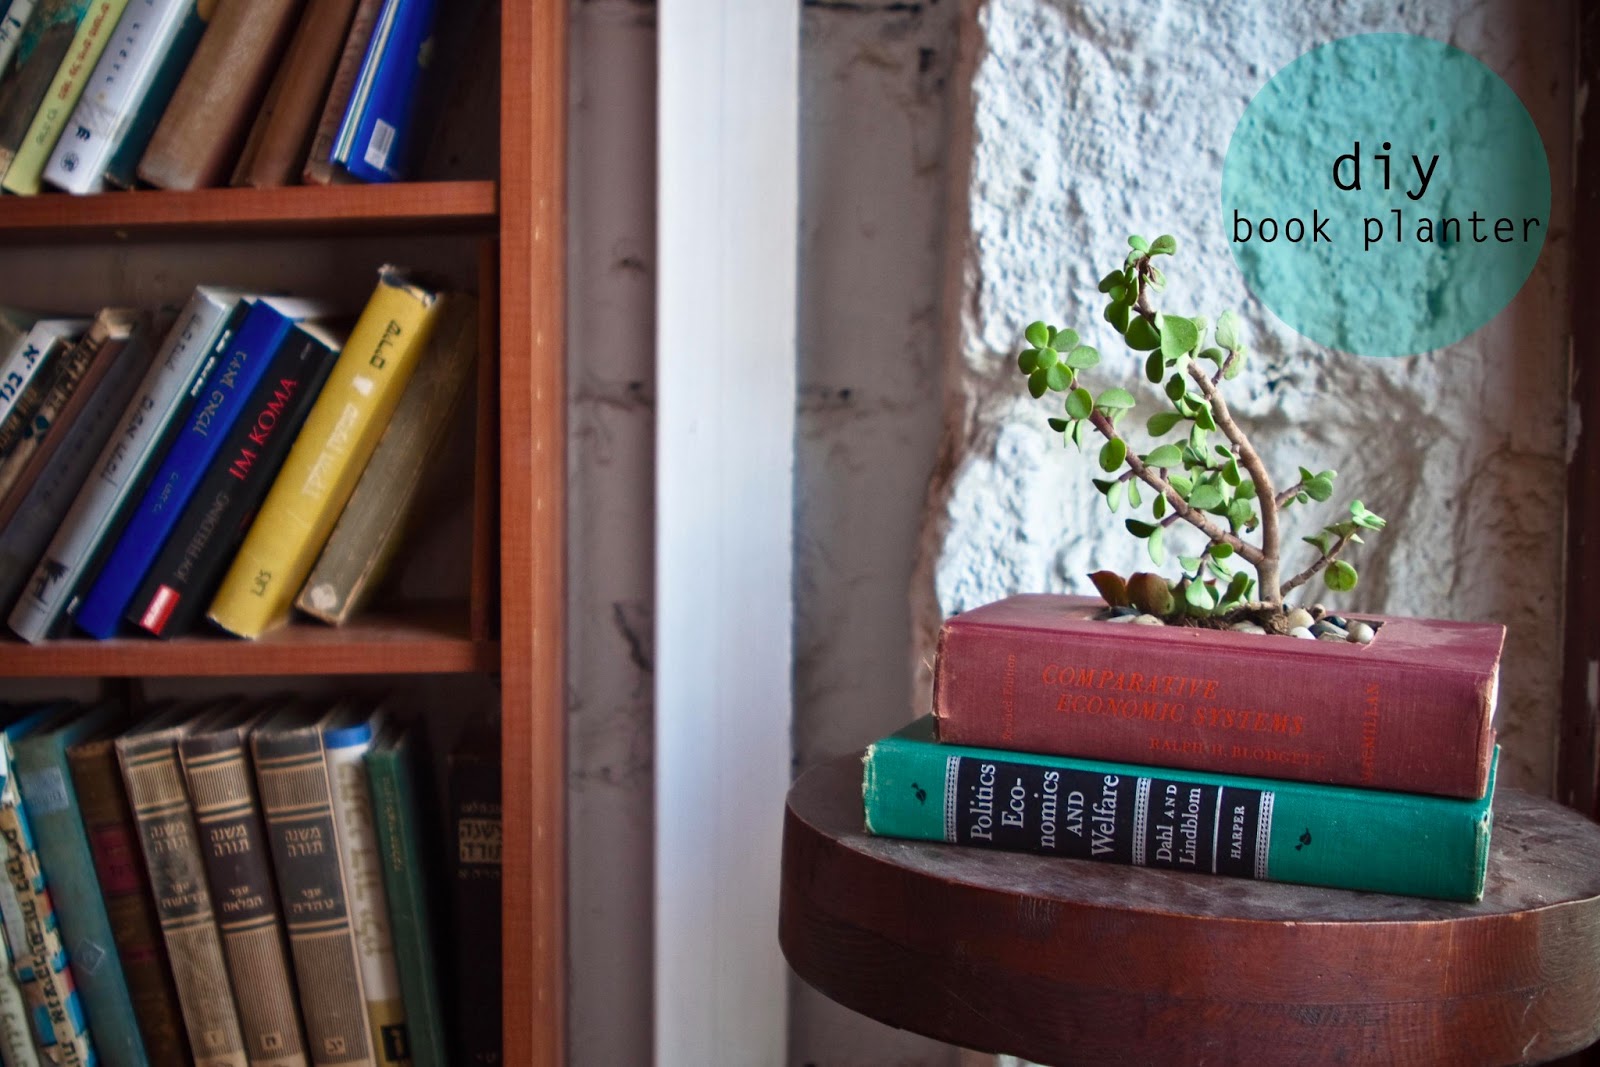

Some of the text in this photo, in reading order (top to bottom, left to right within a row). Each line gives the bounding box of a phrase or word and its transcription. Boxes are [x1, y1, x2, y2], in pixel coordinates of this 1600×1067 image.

[369, 319, 401, 370] שירים
[229, 377, 297, 480] IM KOMA
[1042, 664, 1220, 700] COMPARATIVE
[1056, 693, 1304, 737] ECONOMIC SYSTEMS
[1149, 737, 1203, 754] RALPH
[970, 763, 996, 842] Politics
[1001, 777, 1025, 829] Eco-
[1034, 770, 1060, 849] nomics
[1066, 790, 1085, 837] AND
[1092, 774, 1120, 856] Welfare
[1156, 784, 1178, 863] Dahl AND
[1179, 788, 1201, 865] Lindblom
[211, 823, 247, 842] משנה
[214, 838, 250, 857] תורה
[285, 826, 321, 843] משנה
[287, 840, 323, 858] תורה
[1230, 805, 1245, 860] HARPER
